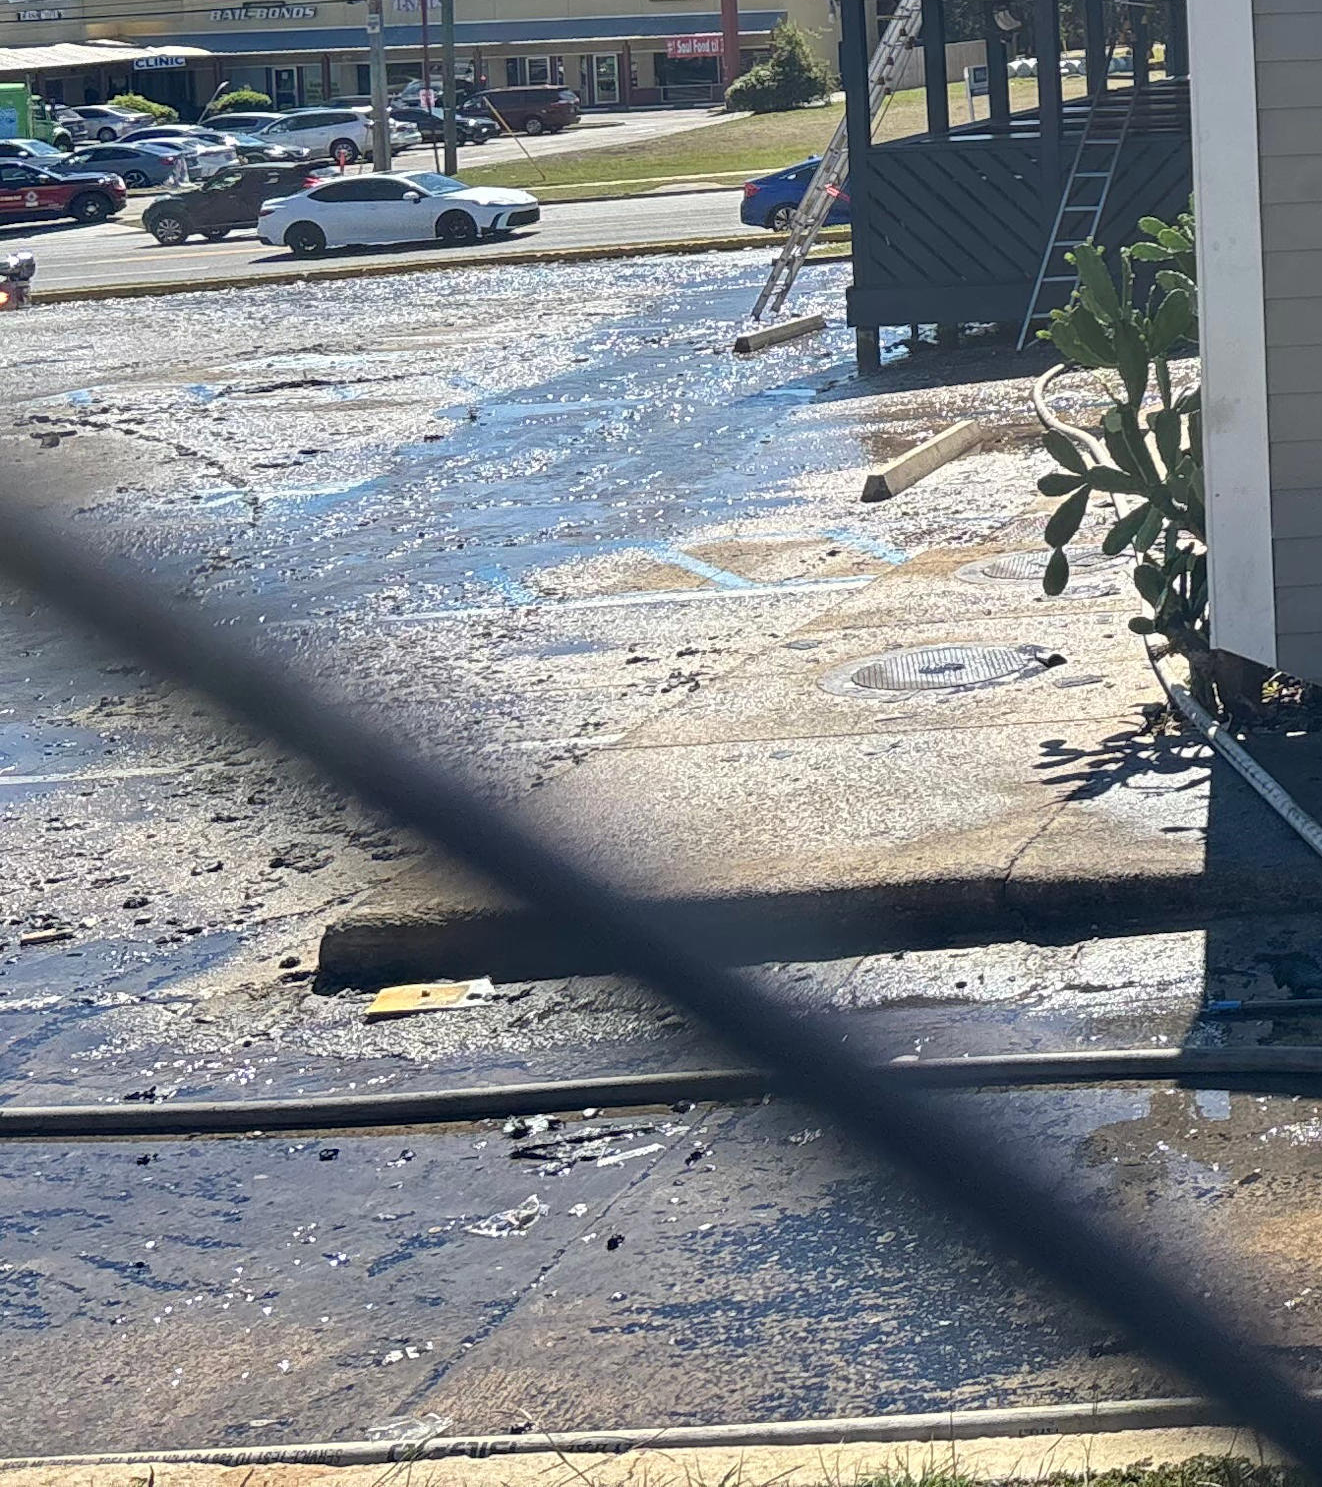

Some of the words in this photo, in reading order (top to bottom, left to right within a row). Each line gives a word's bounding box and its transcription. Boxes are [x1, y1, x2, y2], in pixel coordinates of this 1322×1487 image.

[254, 7, 316, 19] BONDS
[677, 40, 692, 53] Soul
[693, 38, 710, 52] Food
[135, 57, 184, 68] CLINIC
